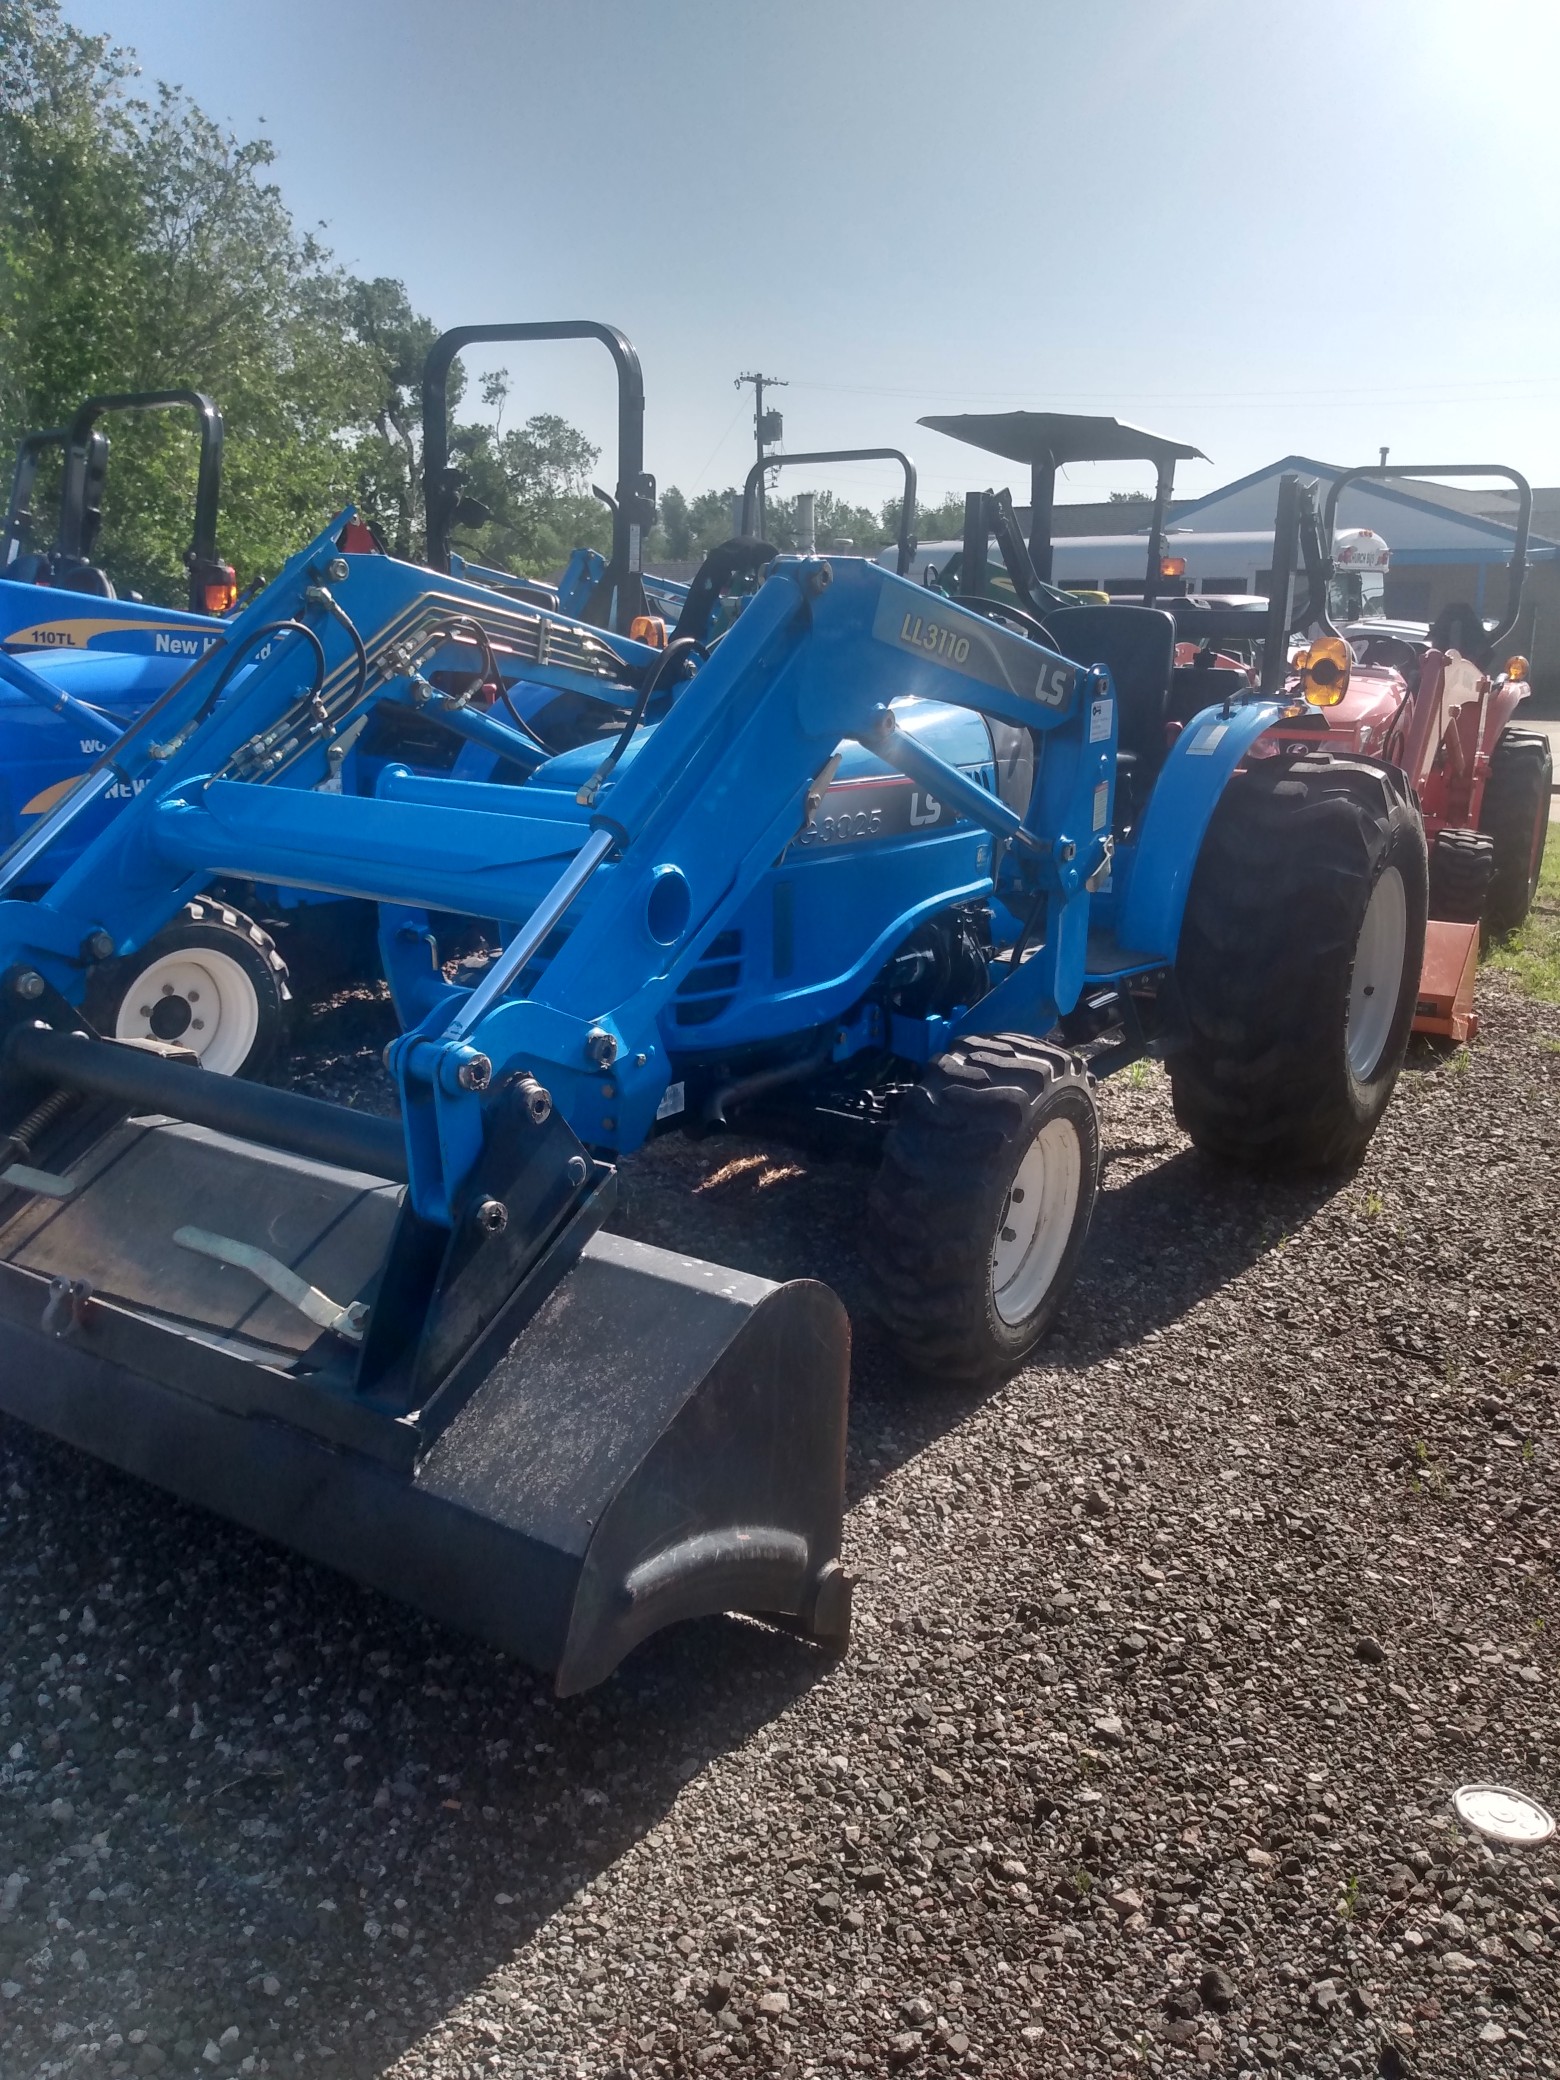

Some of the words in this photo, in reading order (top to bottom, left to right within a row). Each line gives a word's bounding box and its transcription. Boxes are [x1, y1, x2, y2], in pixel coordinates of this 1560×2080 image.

[31, 630, 76, 646] 110TL
[155, 633, 199, 655] New
[900, 612, 971, 664] LL3110
[1035, 663, 1067, 706] LS
[910, 792, 942, 827] LS
